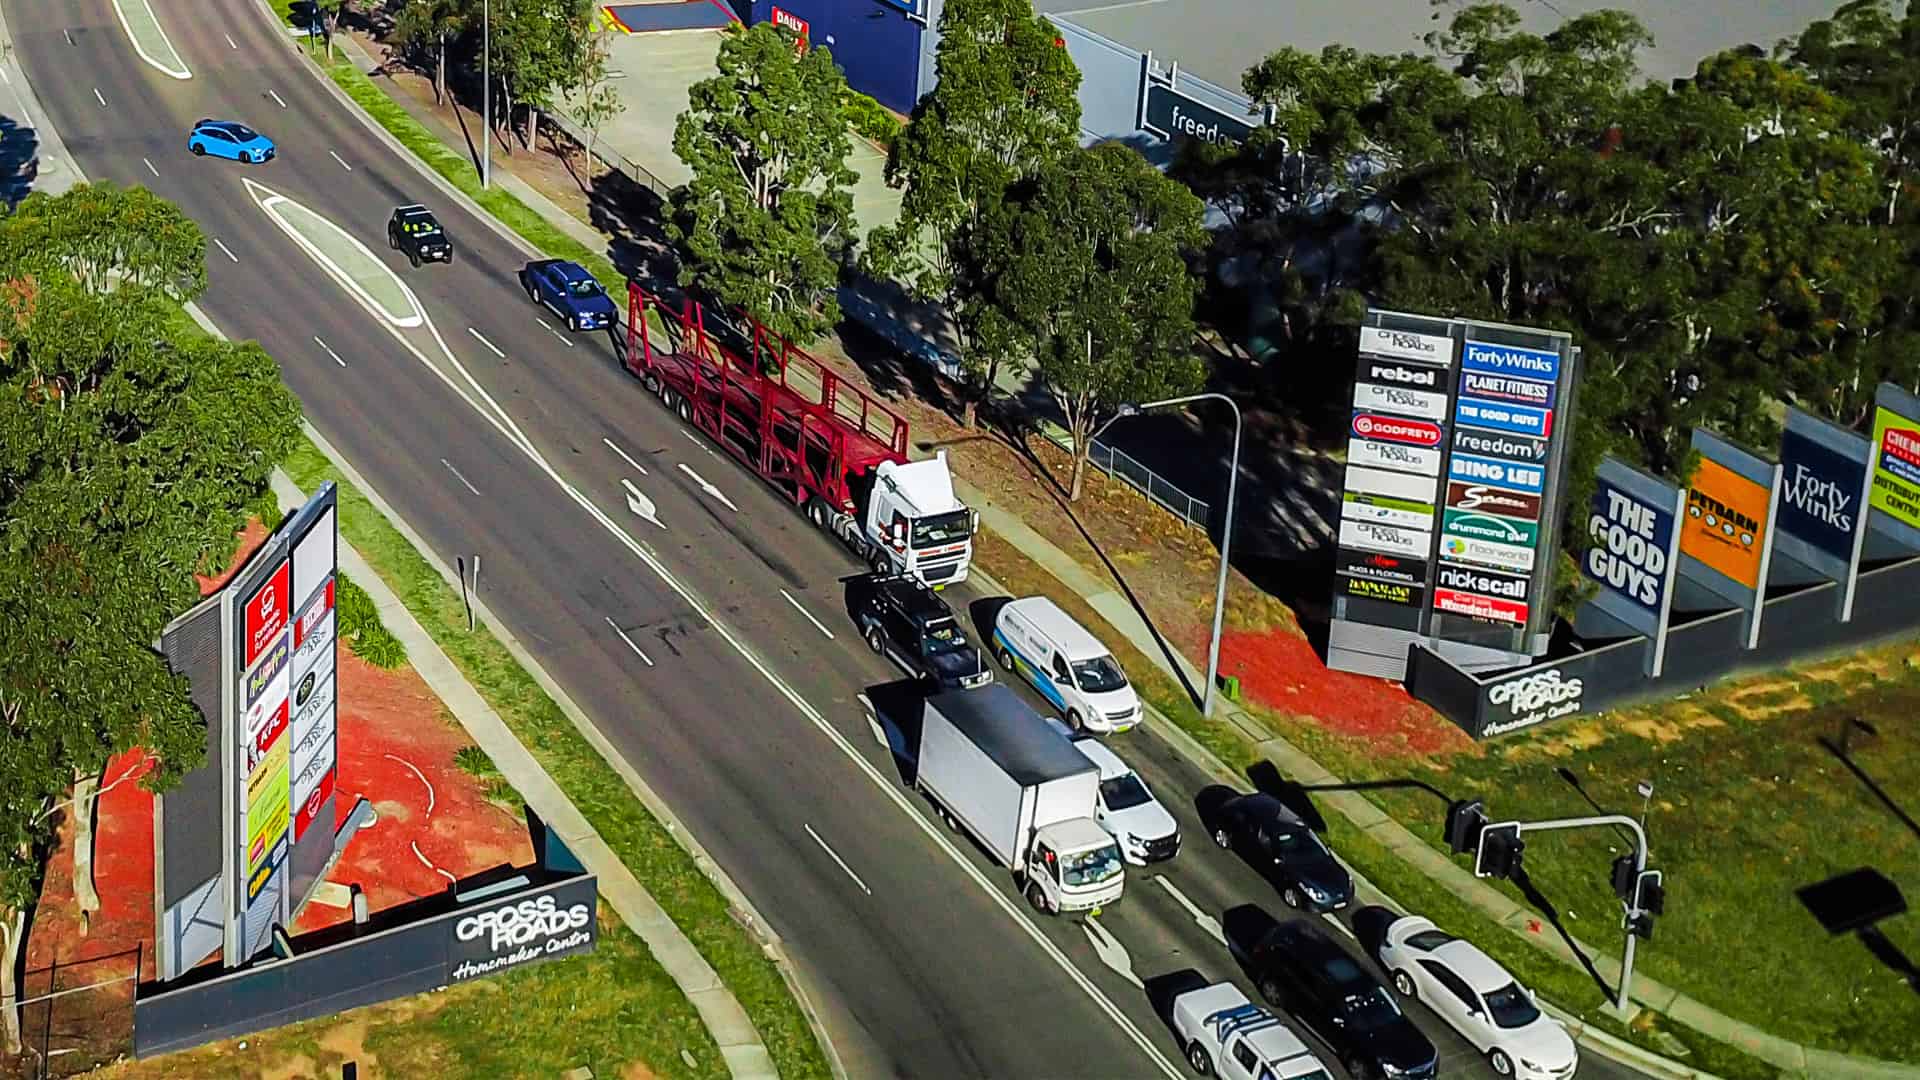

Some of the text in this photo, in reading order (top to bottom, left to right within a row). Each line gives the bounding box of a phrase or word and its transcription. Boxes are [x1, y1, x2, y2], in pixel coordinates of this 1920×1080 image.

[777, 10, 803, 31] DAILY
[1371, 366, 1434, 385] rebel
[1466, 374, 1506, 392] PLANET
[1506, 380, 1548, 398] FITNESS
[1373, 423, 1437, 440] GODFREYS
[1460, 405, 1539, 426] THE GOOD GUYS
[1455, 431, 1532, 458] freedom
[1452, 459, 1541, 487] BING LEE
[1795, 463, 1851, 512] Forty
[1607, 488, 1657, 540] THE
[1690, 488, 1758, 534] PETBARN
[1782, 477, 1851, 533] Winks
[1449, 522, 1506, 538] drummond
[1590, 514, 1665, 576] GOOD
[1589, 547, 1659, 605] GUYS
[1441, 598, 1517, 620] Wonderland
[1489, 669, 1561, 705] CROSS
[1511, 678, 1583, 714] ROADS
[456, 895, 556, 941] CROSS
[491, 904, 589, 951] ROADS
[453, 931, 590, 980] Homemaker Centre
